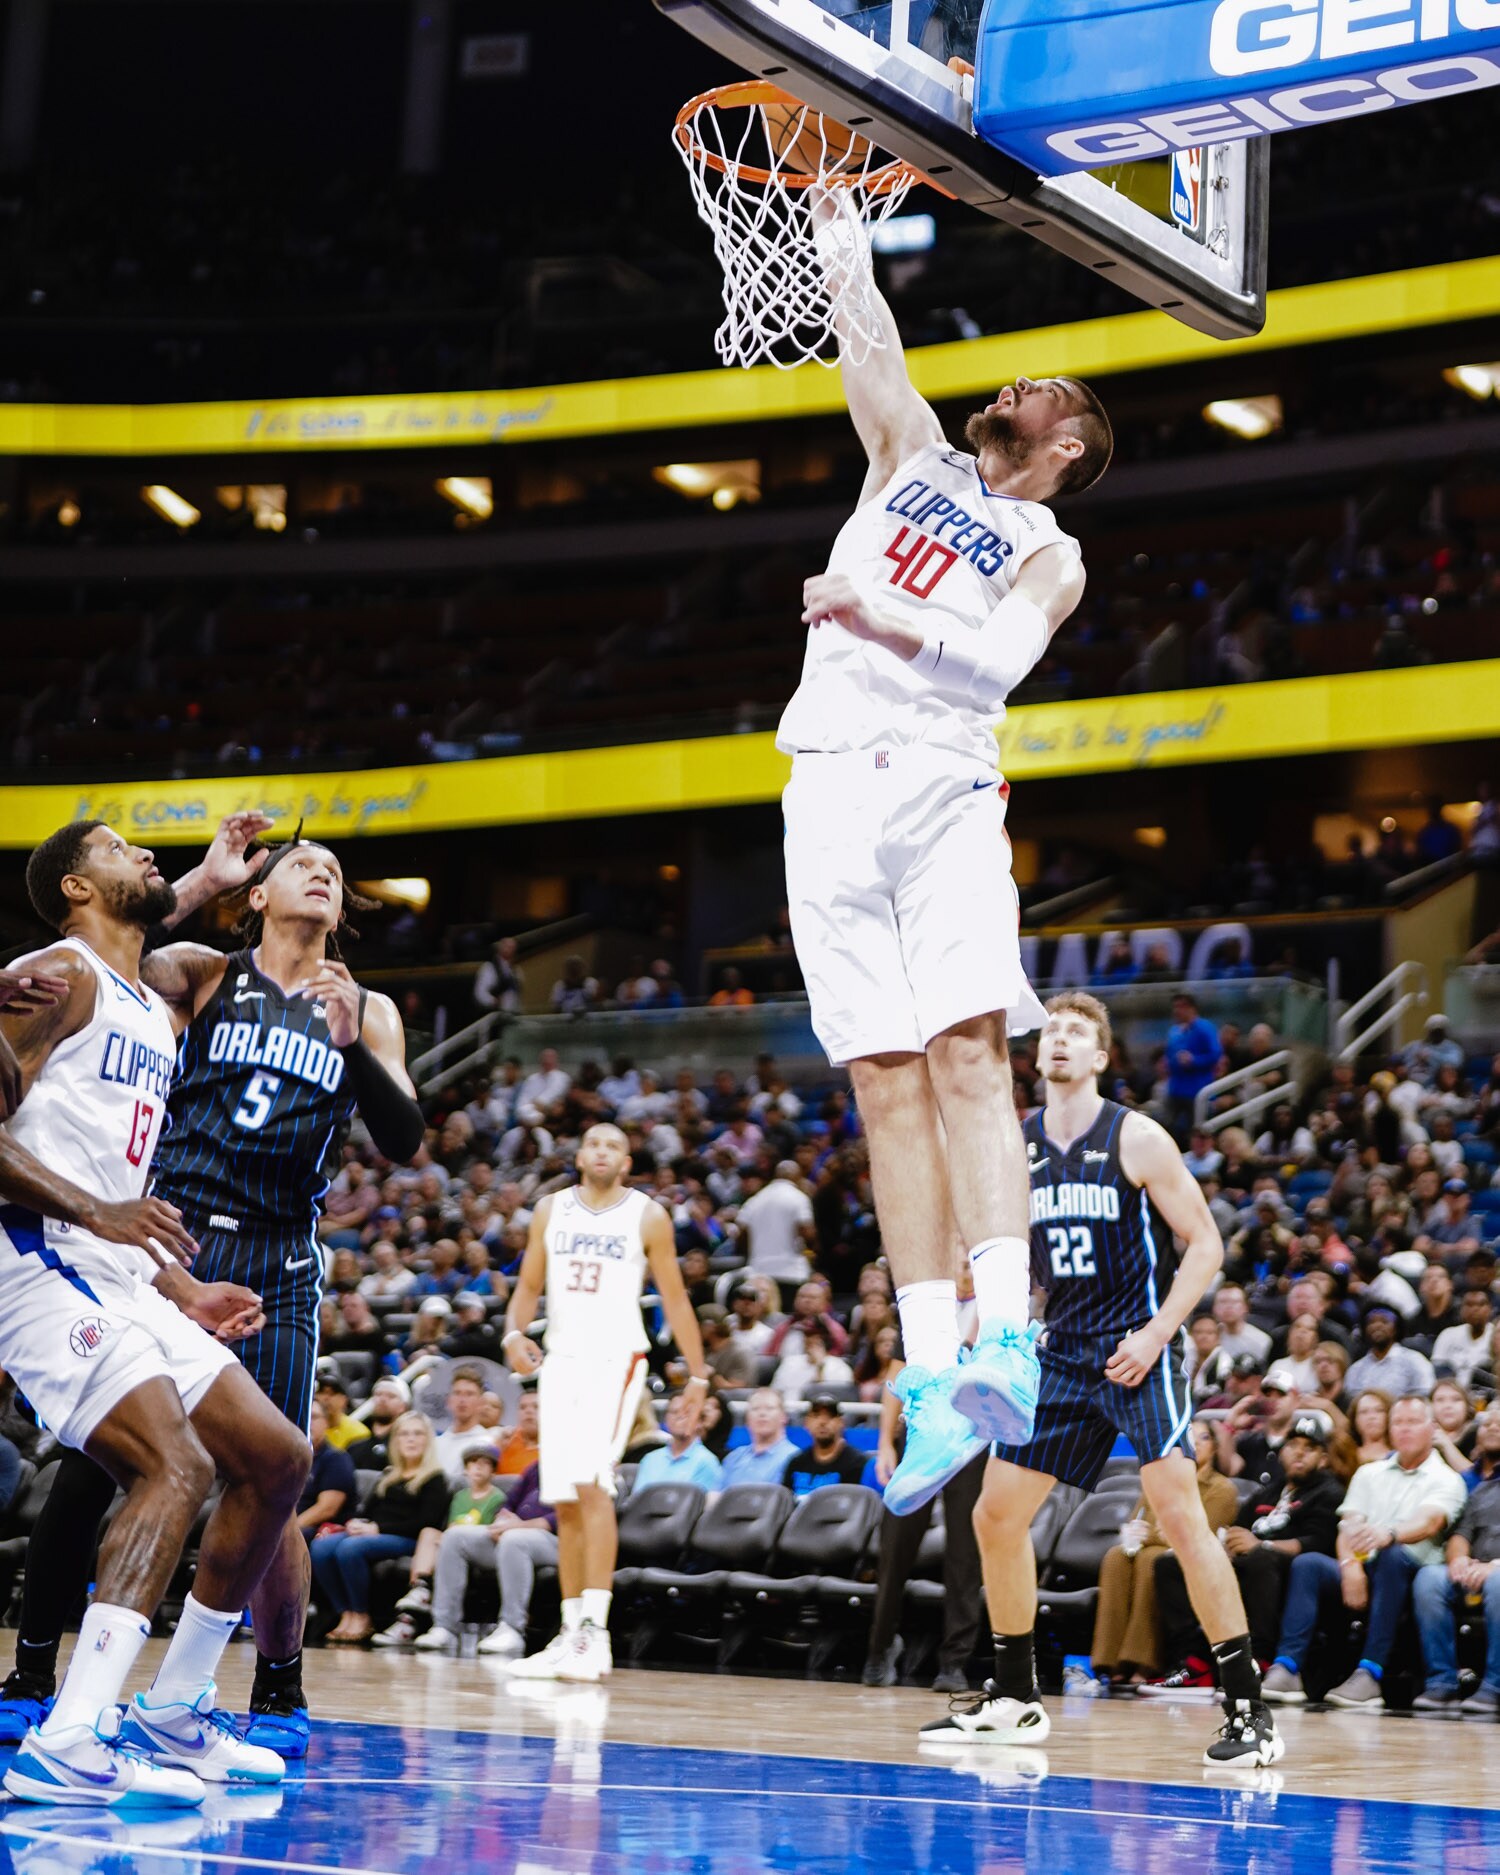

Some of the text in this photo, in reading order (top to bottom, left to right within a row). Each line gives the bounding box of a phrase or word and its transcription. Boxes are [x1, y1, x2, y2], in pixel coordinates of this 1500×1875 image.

[1209, 0, 1500, 76] GEI
[1046, 57, 1500, 163] GEICO
[885, 478, 1013, 577] CLIPPERS
[883, 525, 959, 600] 40
[98, 1029, 174, 1102] CLIPPER
[208, 1022, 345, 1094] ORLANDO
[126, 1099, 154, 1168] 13
[233, 1069, 281, 1130] 5
[209, 1214, 239, 1231] MAGIC
[1029, 1183, 1120, 1225] RLANDO
[554, 1230, 627, 1260] CLIPPERS
[566, 1261, 602, 1294] 33
[1047, 1226, 1096, 1278] 22
